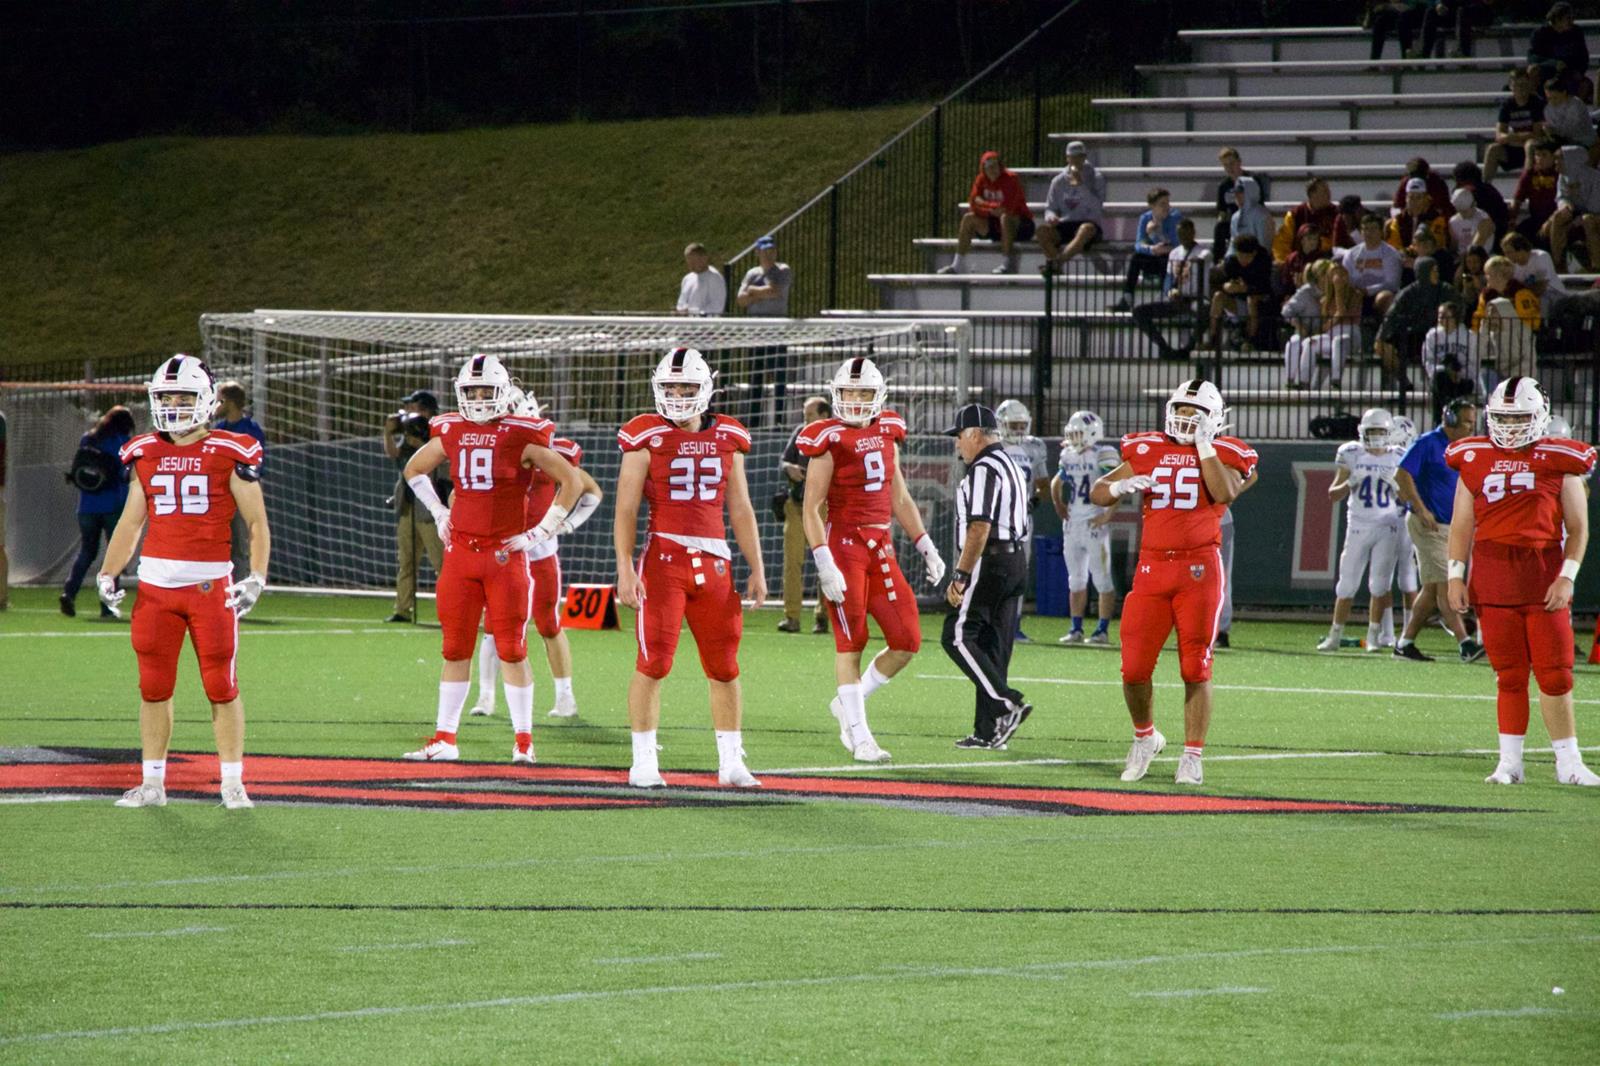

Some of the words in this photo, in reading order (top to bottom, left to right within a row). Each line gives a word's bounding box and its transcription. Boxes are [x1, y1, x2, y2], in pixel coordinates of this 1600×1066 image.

[458, 433, 497, 447] JESUITS
[677, 441, 717, 455] JESUITS
[854, 435, 885, 453] JESUITS
[156, 456, 202, 472] JESUITS
[458, 448, 494, 490] 18
[864, 451, 885, 492] 9
[1159, 454, 1197, 467] JESUITS
[1490, 460, 1530, 473] JESUITS
[669, 457, 722, 501] 32
[1150, 467, 1201, 510] 55
[1359, 475, 1391, 509] 40
[567, 587, 602, 619] 30
